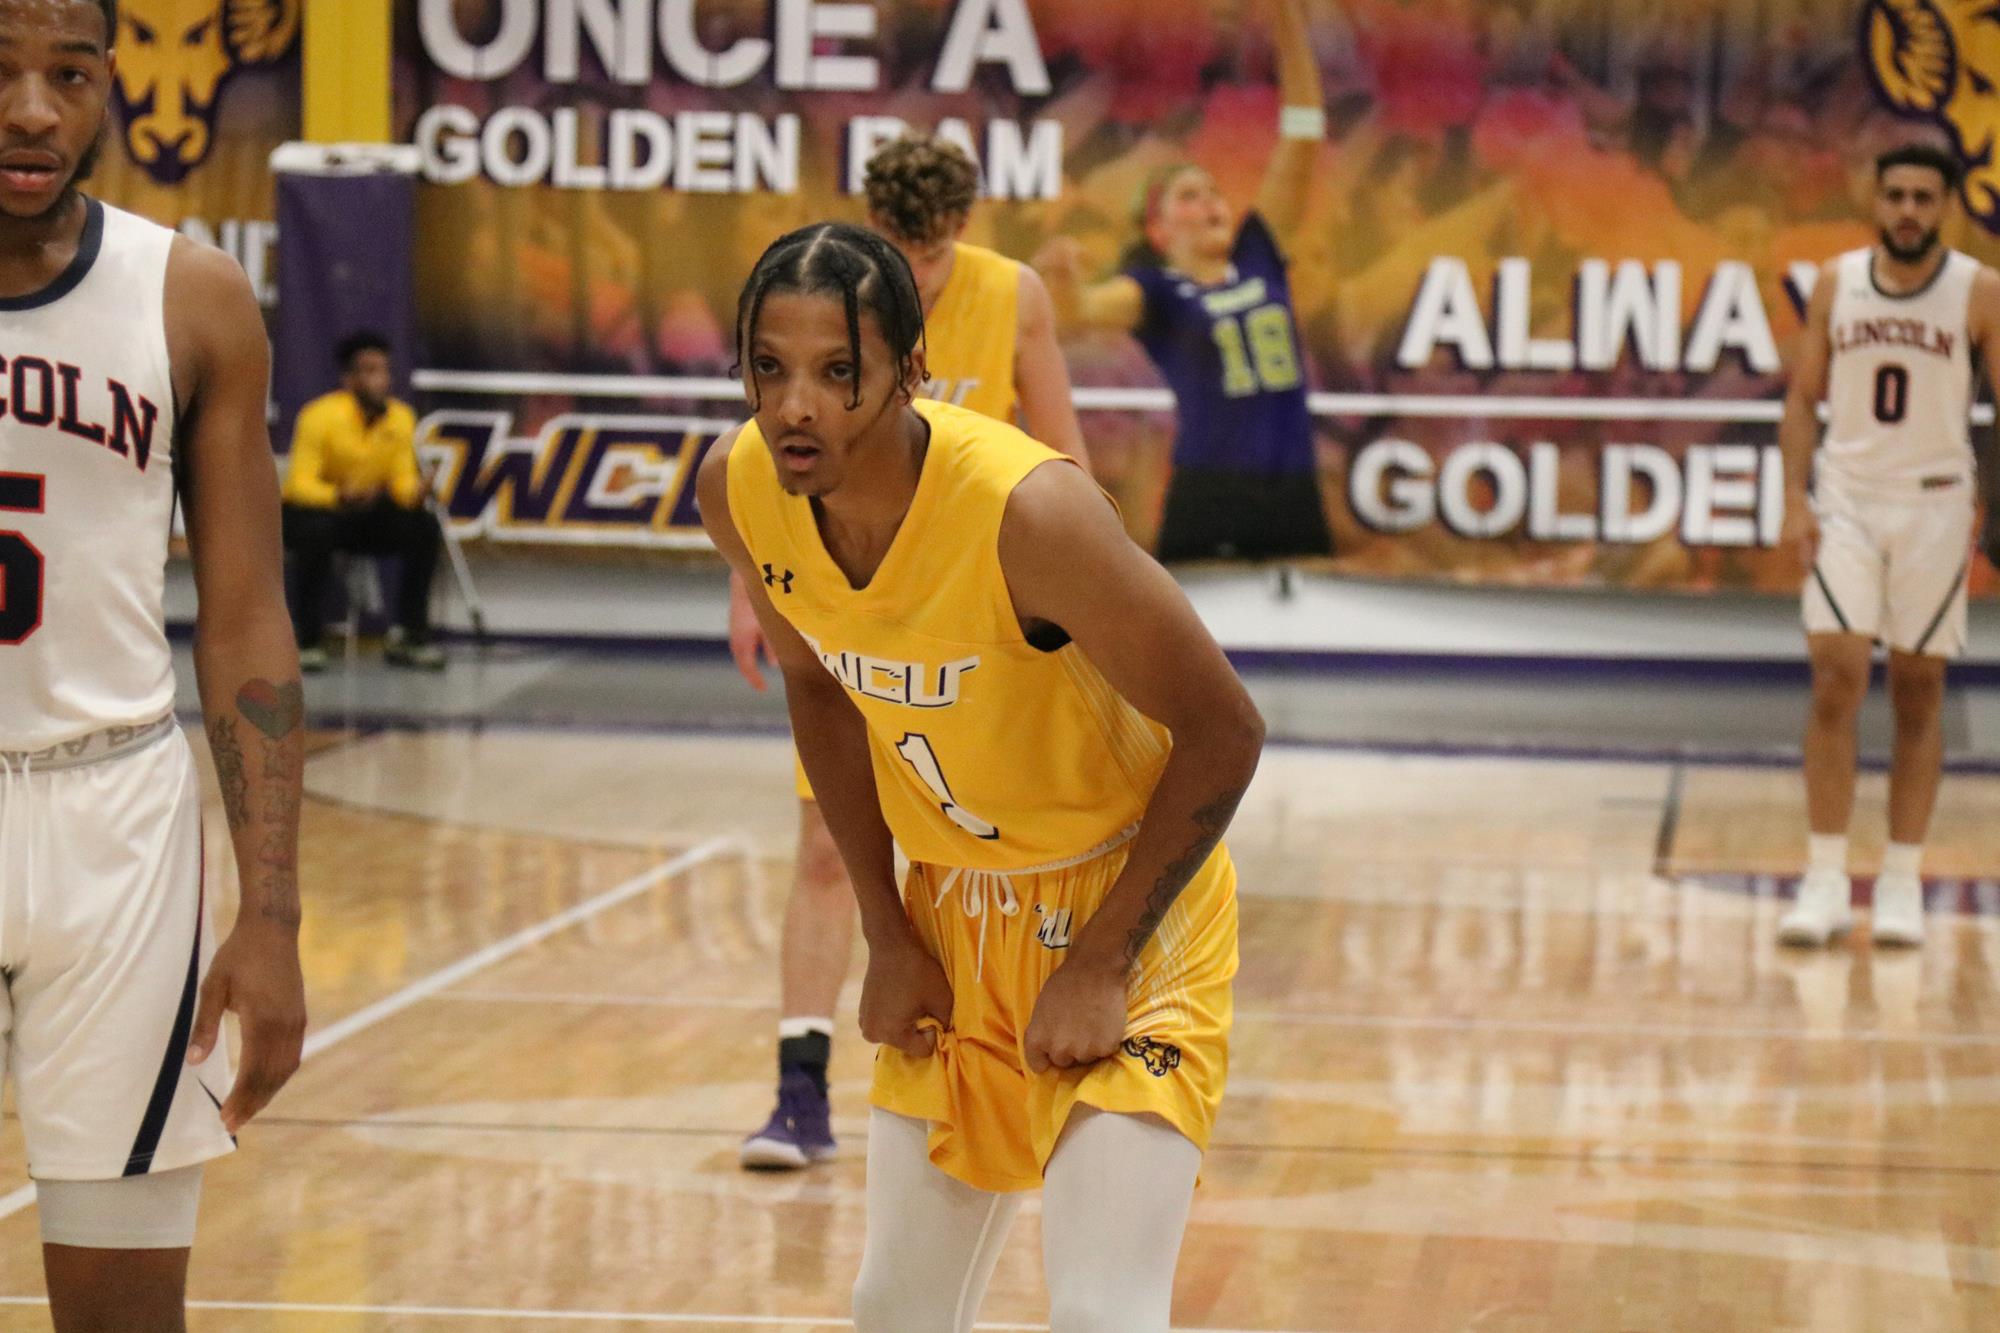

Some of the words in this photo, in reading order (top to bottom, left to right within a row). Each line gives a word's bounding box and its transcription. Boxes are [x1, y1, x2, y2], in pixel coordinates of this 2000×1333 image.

[418, 0, 880, 91] ONCE
[931, 0, 1051, 95] A
[414, 105, 799, 194] GOLDEN
[1398, 256, 1820, 373] ALWA
[1834, 316, 1955, 361] LINCOLN
[0, 355, 158, 474] OLN
[1873, 361, 1910, 426] 0
[414, 409, 740, 549] WC
[894, 731, 998, 841] 1
